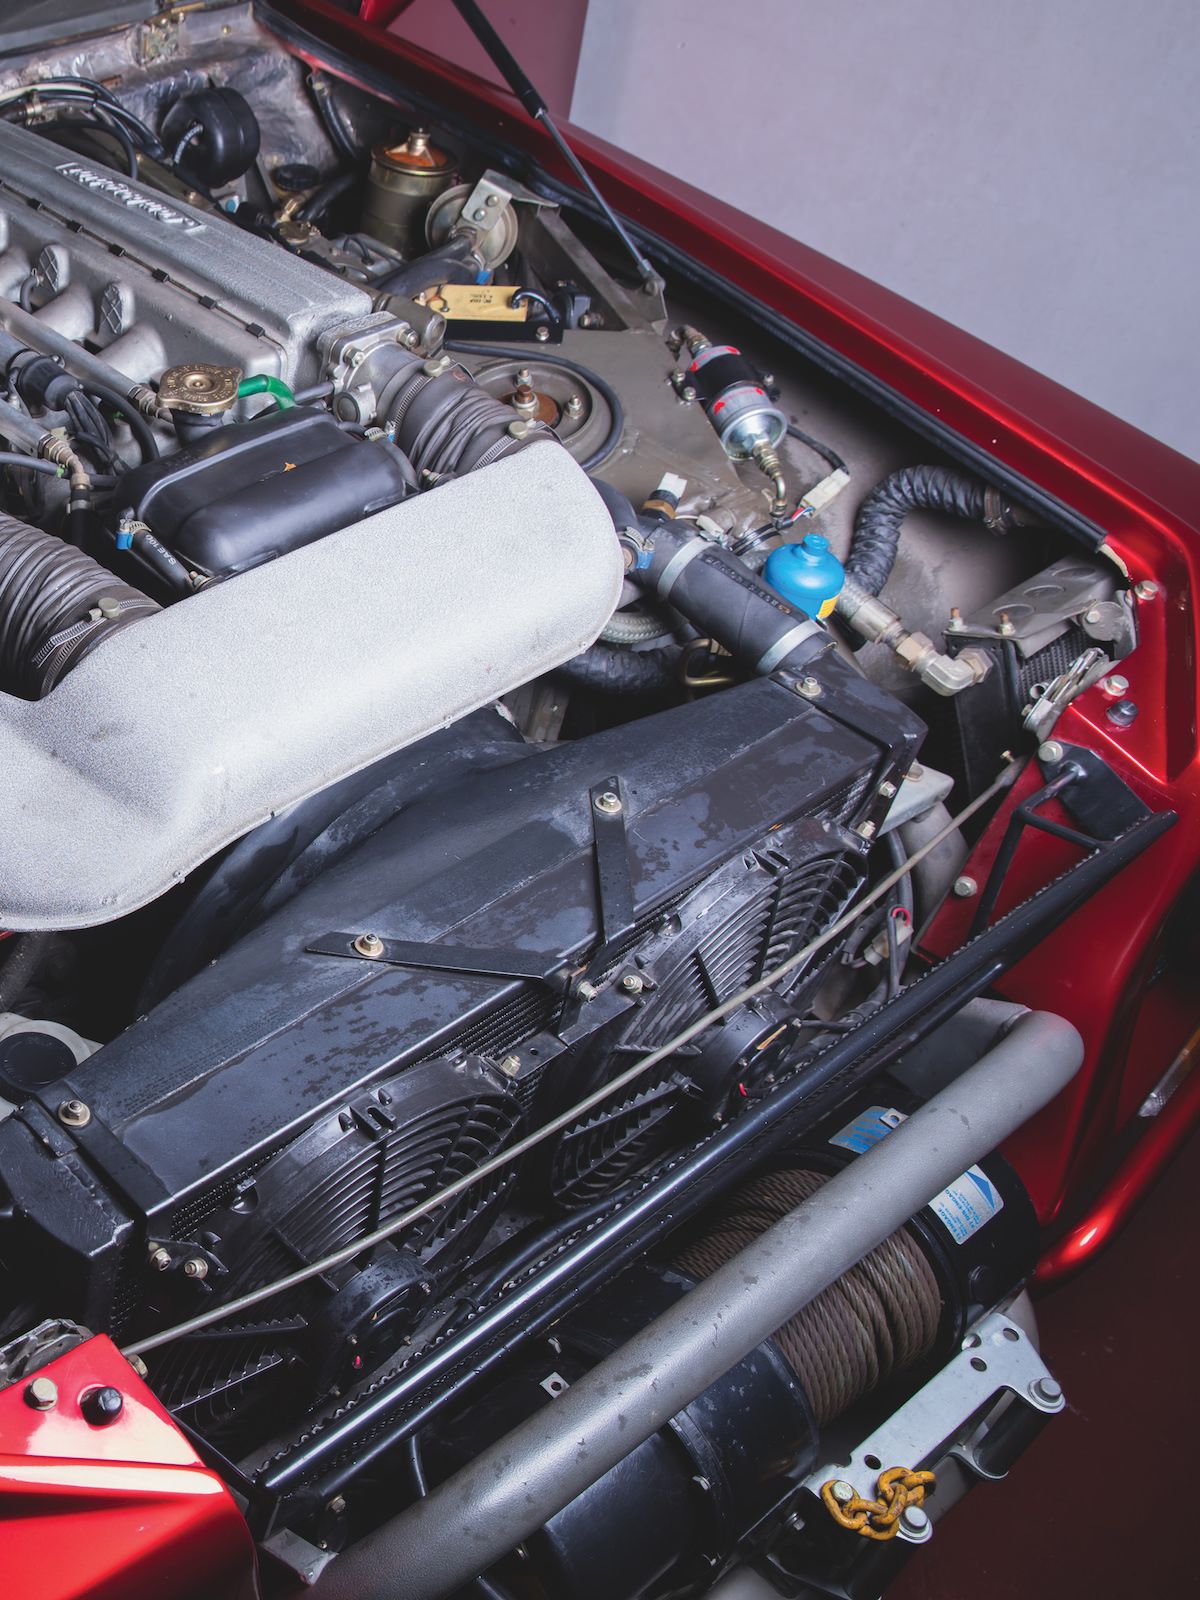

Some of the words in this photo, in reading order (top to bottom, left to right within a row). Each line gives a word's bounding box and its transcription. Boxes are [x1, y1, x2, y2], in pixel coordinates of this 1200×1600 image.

[145, 534, 160, 548] 100
[157, 547, 177, 565] SAE
[944, 1188, 971, 1221] DIS-ENGAG
